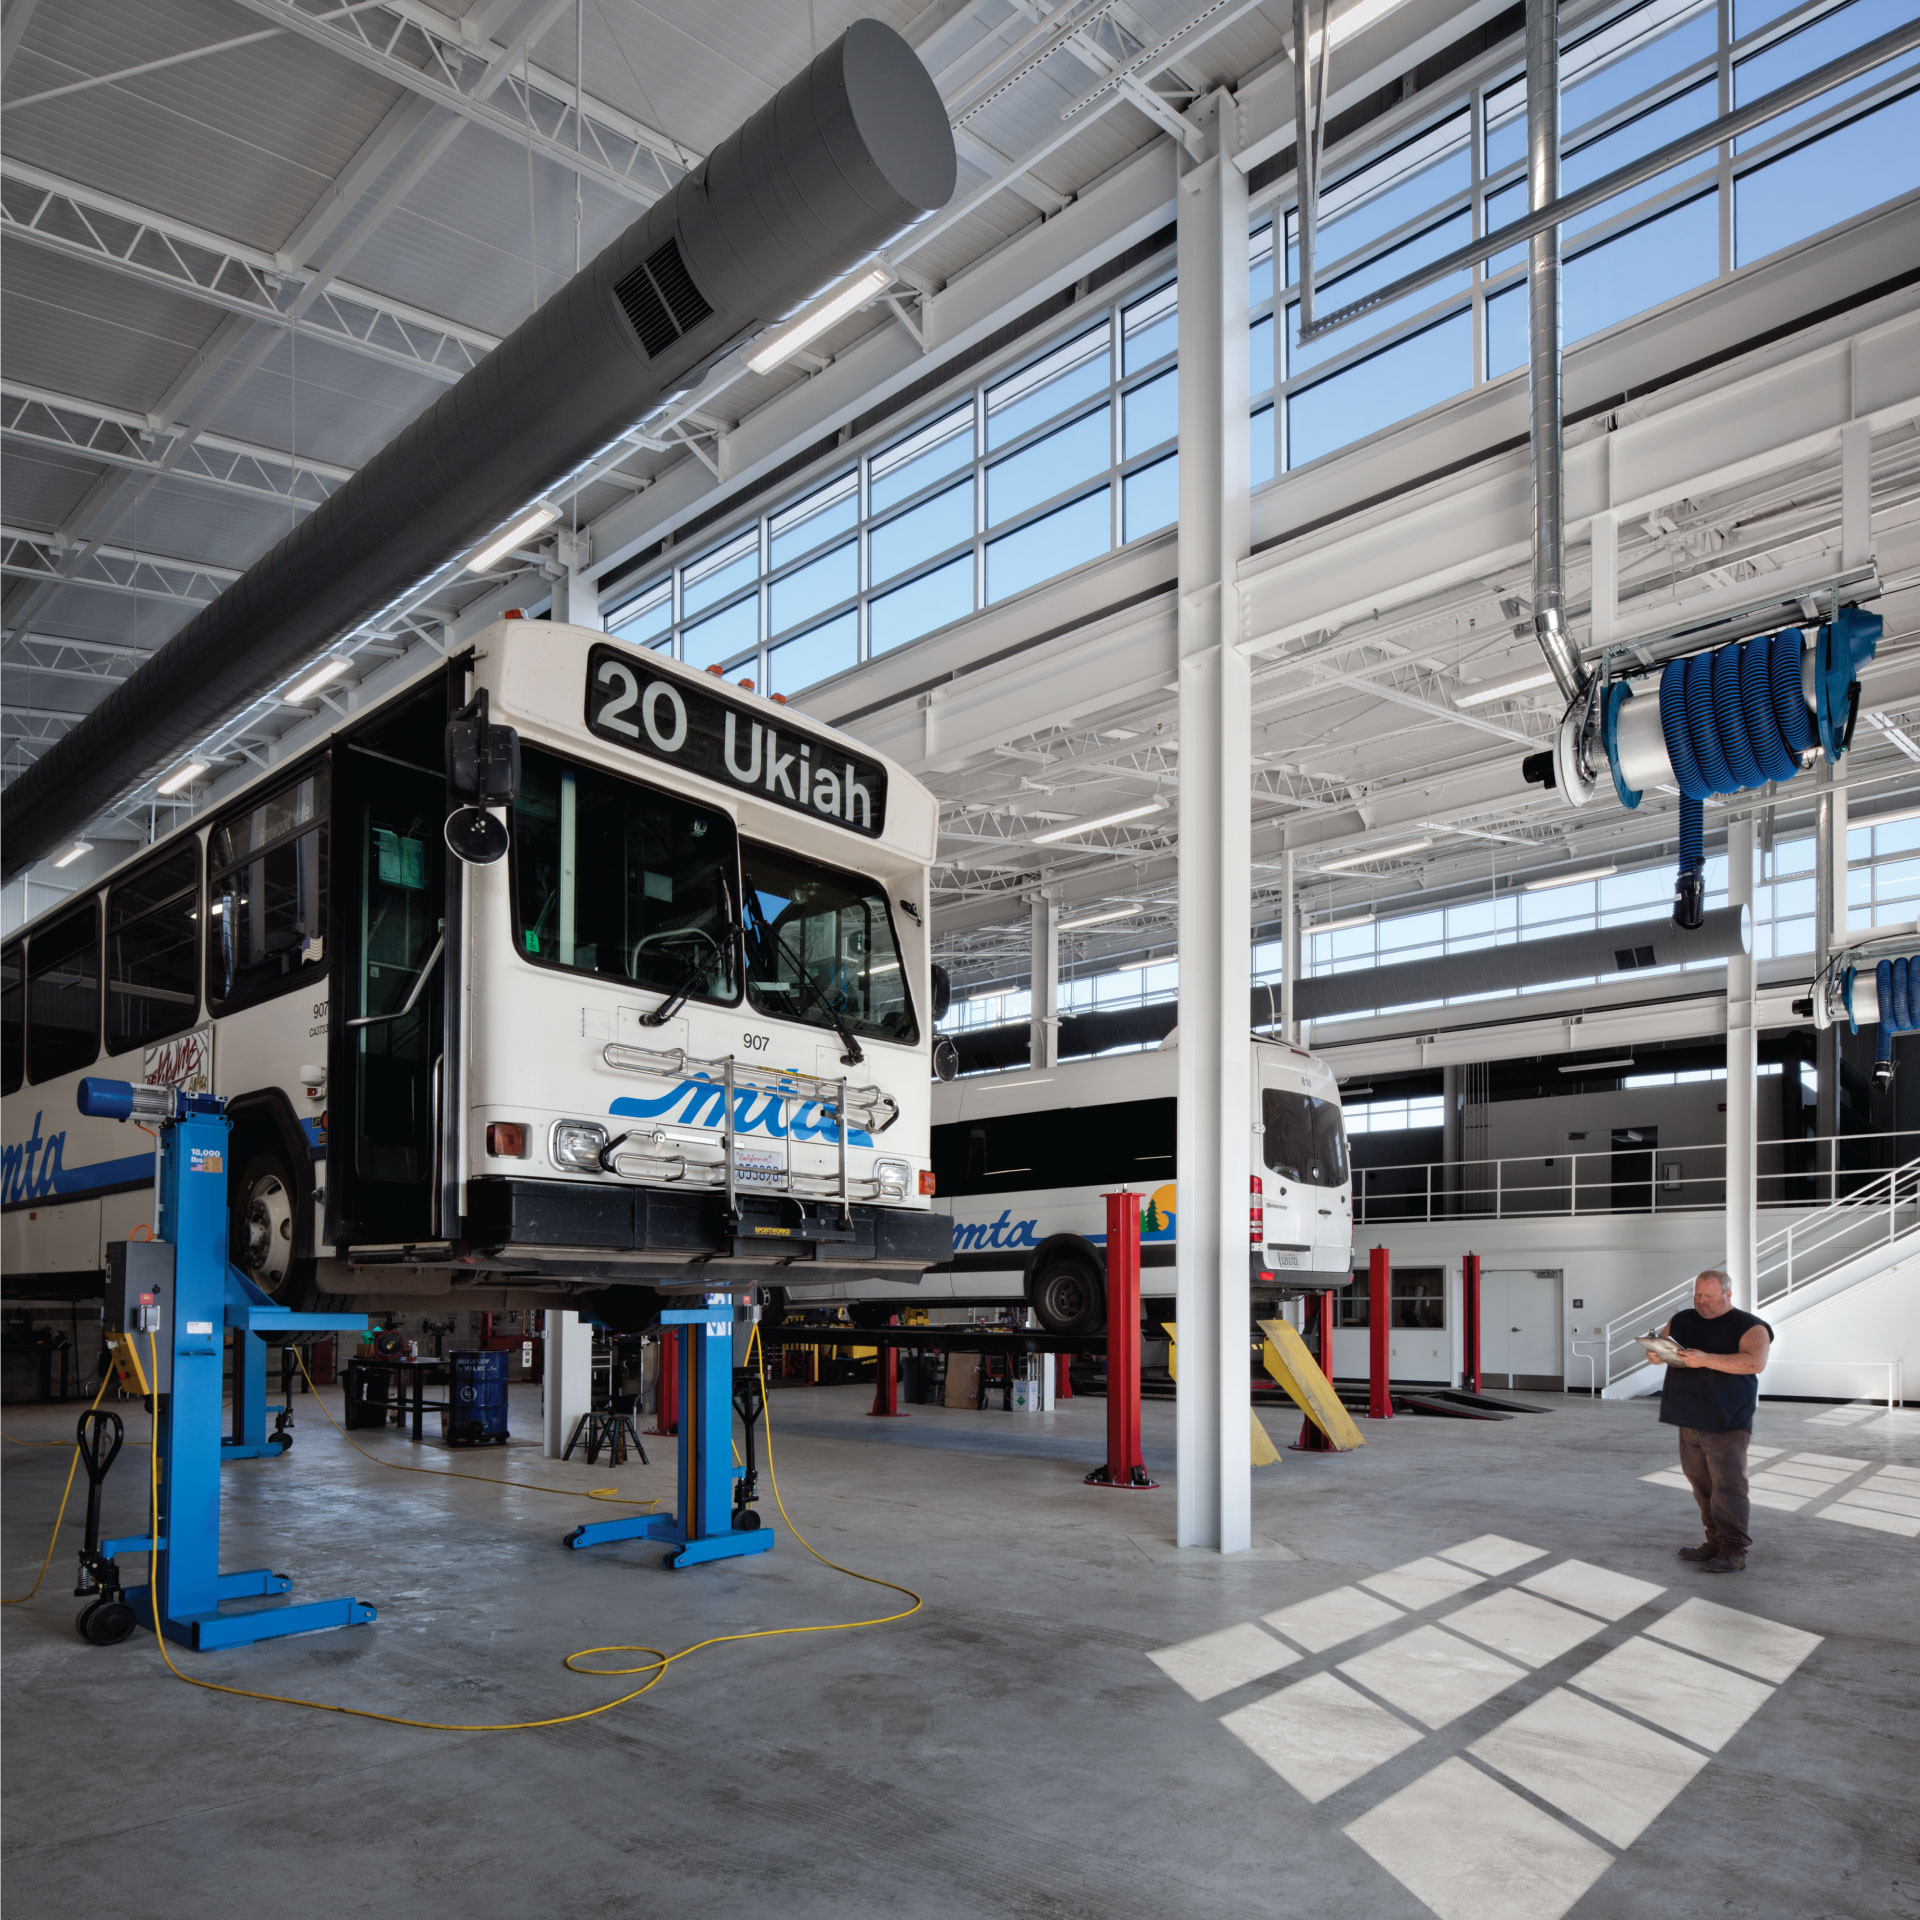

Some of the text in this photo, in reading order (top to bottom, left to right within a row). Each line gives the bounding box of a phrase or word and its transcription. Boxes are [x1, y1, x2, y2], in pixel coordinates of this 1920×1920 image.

[597, 660, 871, 829] 20 Ukiah
[530, 932, 535, 942] 2
[313, 1000, 329, 1019] 907
[743, 1033, 770, 1051] 907
[609, 1068, 875, 1148] mta
[1, 1110, 67, 1206] mta
[191, 1148, 221, 1157] 18,000
[952, 1209, 1039, 1250] mta
